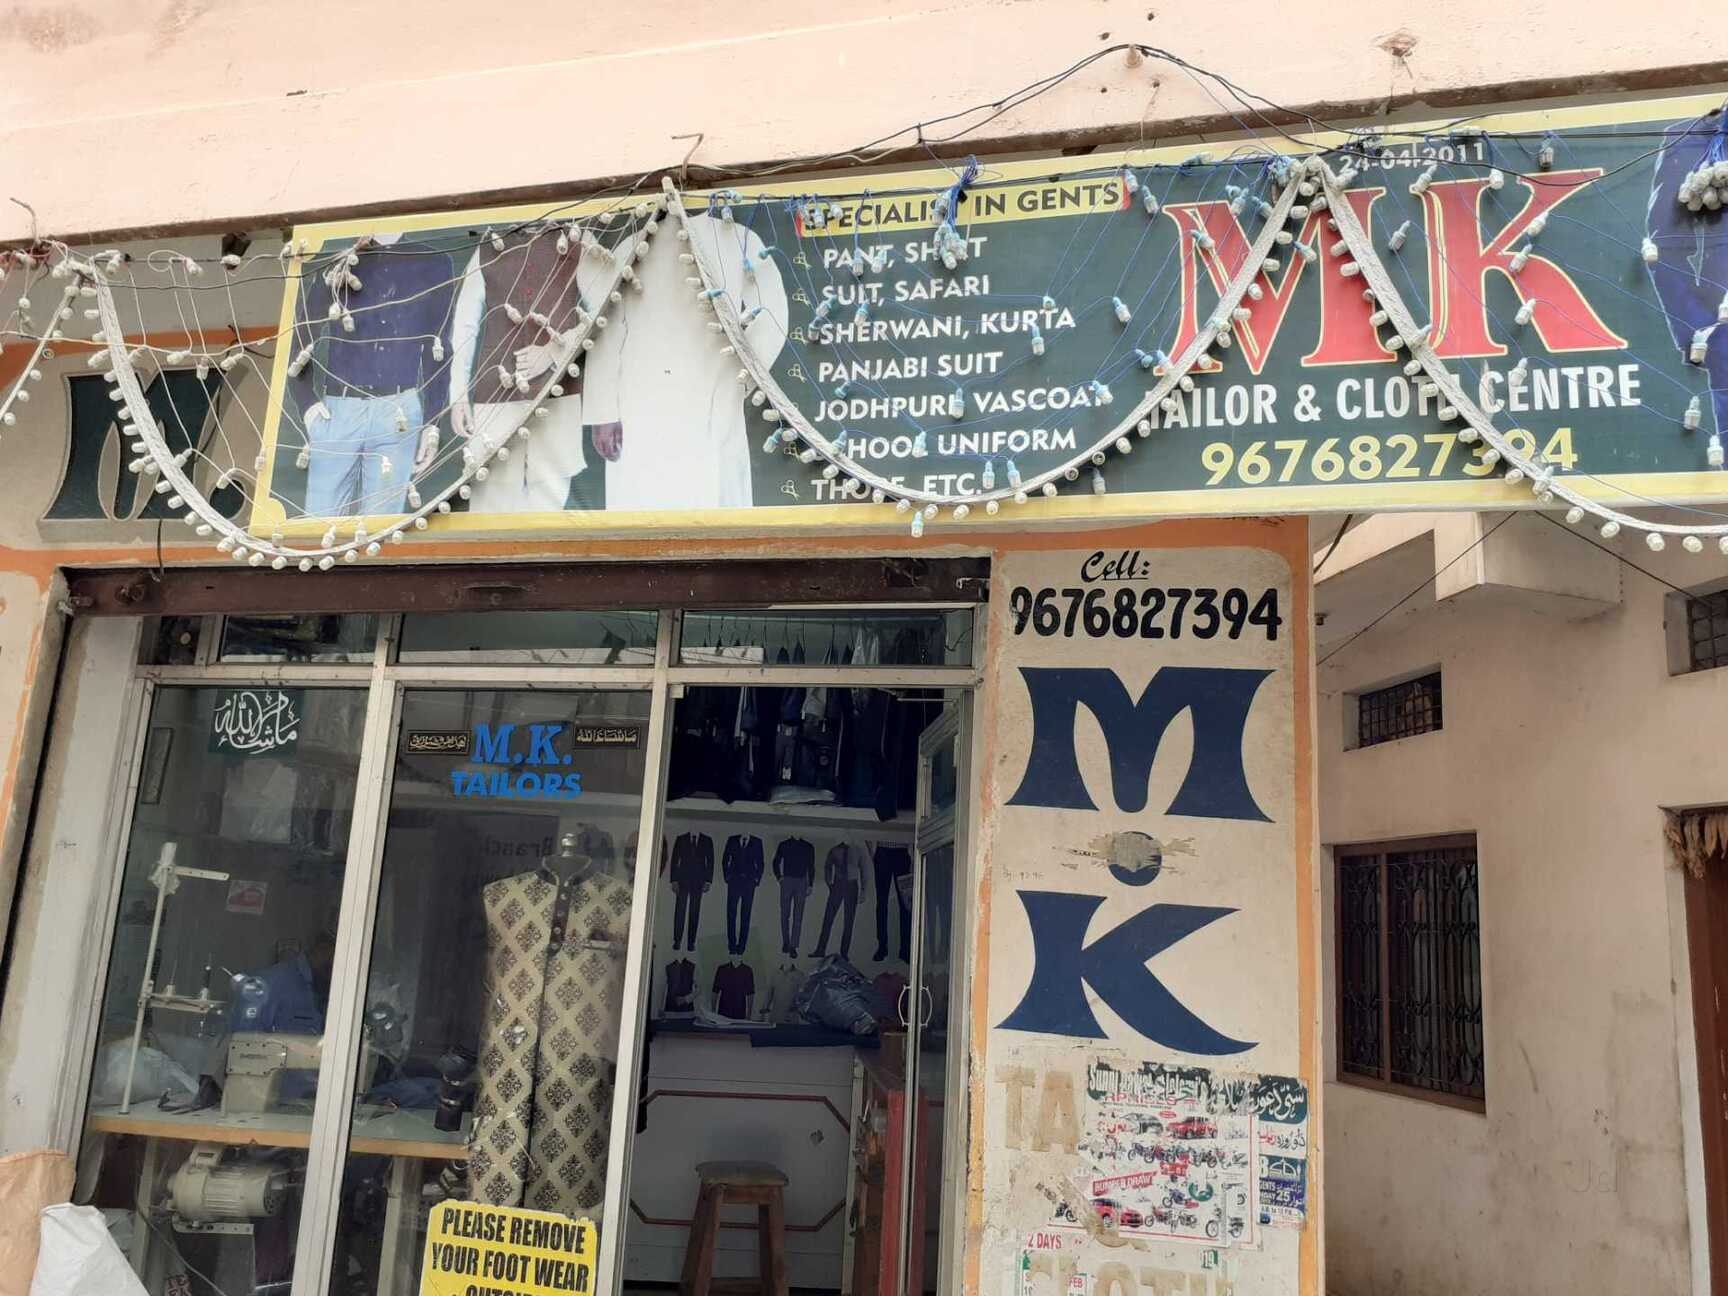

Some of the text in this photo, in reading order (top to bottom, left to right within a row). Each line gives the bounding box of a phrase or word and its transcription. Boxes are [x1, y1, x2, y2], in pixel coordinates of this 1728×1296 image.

[805, 182, 1120, 230] SPECIALI IN GENTS
[823, 236, 988, 270] PANT, SHT
[822, 274, 990, 308] SUIT, SAFARI
[1153, 168, 1630, 378] MK
[820, 307, 1077, 345] SHERWANI, KURTA
[818, 351, 1003, 383] PANJABI SUIT
[1293, 384, 1322, 423] &
[1478, 363, 1642, 415] CENTRE
[938, 427, 1076, 456] UNIFORM
[1201, 426, 1579, 486] 9676827394
[923, 472, 982, 498] ETC.
[1081, 550, 1151, 583] Cell:
[1010, 585, 1283, 641] 9676827394
[470, 721, 574, 766] M.K.
[450, 770, 585, 799] TAILORS
[441, 1207, 586, 1254] PLEASE REMOVE
[1036, 1232, 1062, 1249] DAYS
[431, 1242, 589, 1293] YOUR FOOT WEAR
